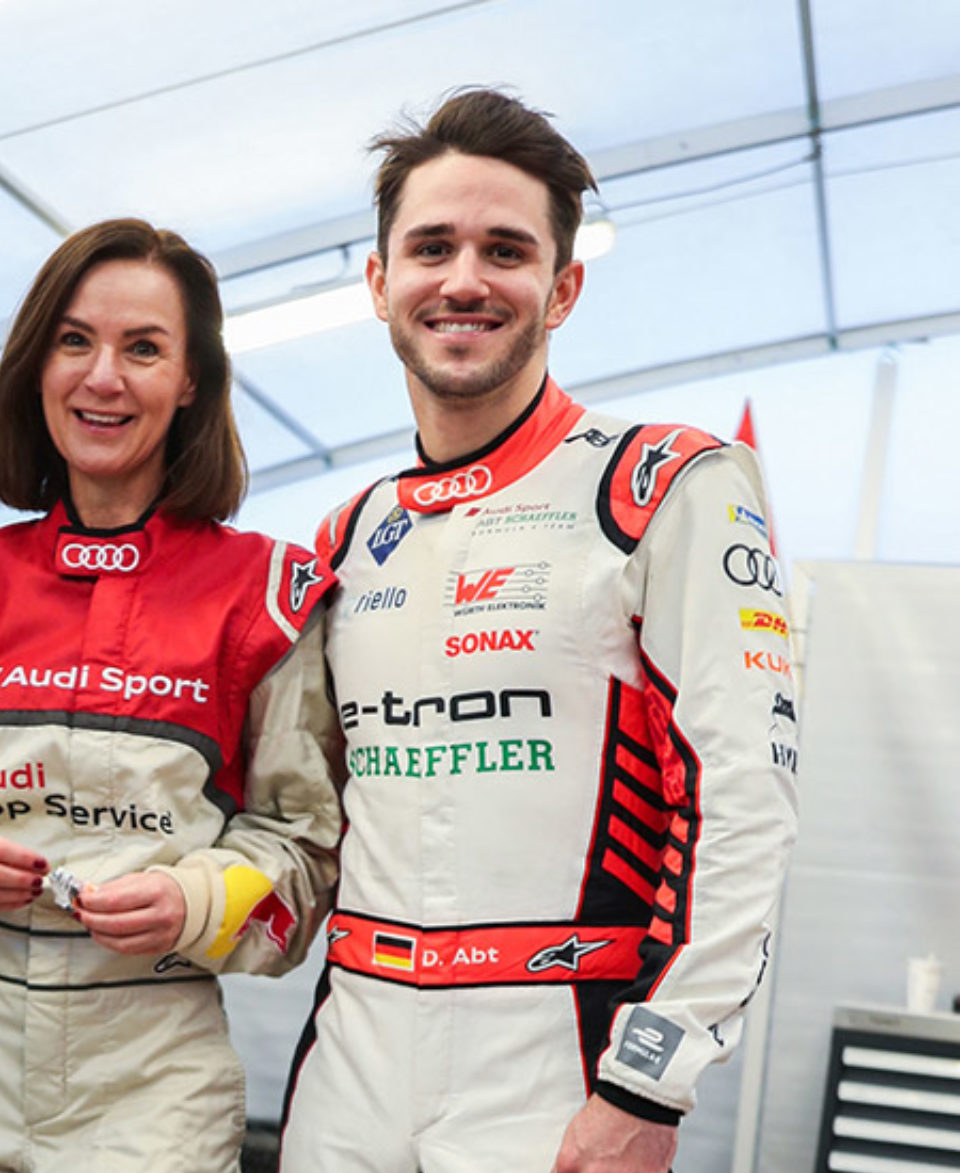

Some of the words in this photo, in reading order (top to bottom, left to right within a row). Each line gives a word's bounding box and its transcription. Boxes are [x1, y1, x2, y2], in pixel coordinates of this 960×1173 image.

[371, 518, 408, 550] LGT
[354, 585, 407, 613] riello
[445, 629, 536, 658] SONAX
[1, 665, 89, 689] Audi
[100, 667, 209, 702] Sport
[341, 689, 552, 731] e-tron
[350, 739, 555, 778] SCHAEFFLER
[44, 794, 174, 834] Service
[422, 950, 444, 967] D.
[452, 947, 499, 965] Abt
